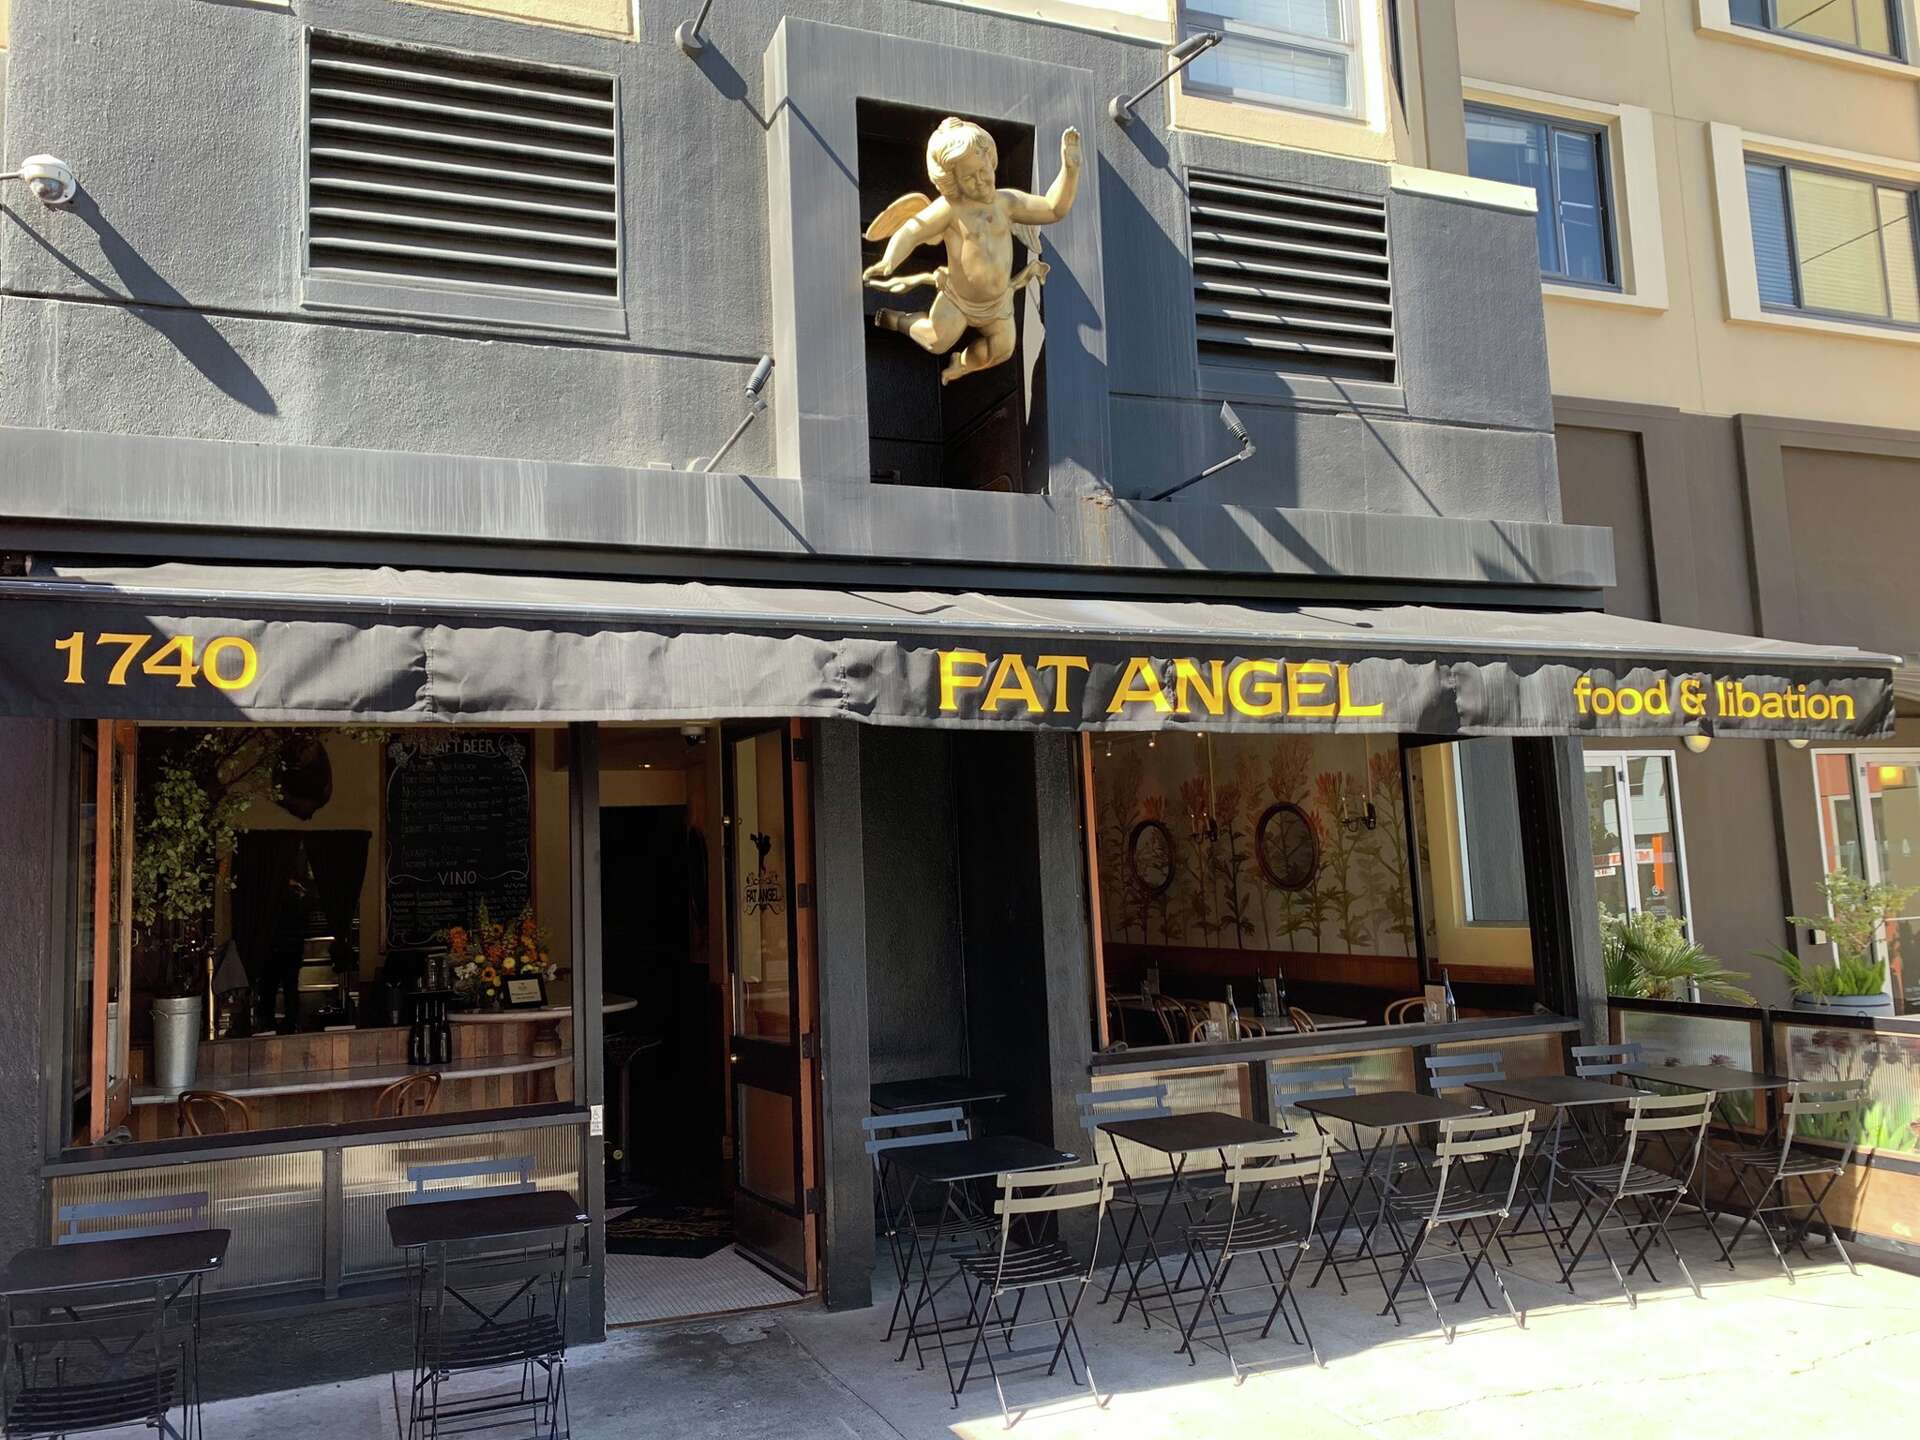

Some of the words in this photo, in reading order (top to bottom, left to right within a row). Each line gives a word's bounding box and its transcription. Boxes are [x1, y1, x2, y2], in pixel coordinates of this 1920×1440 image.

[54, 631, 258, 691] 1740
[936, 651, 1090, 714] FAT
[1105, 657, 1384, 718] ANGEL
[1573, 676, 1671, 716] food
[1680, 678, 1707, 716] &
[1715, 680, 1856, 720] libation
[463, 738, 496, 753] BEER
[437, 870, 478, 886] VINO
